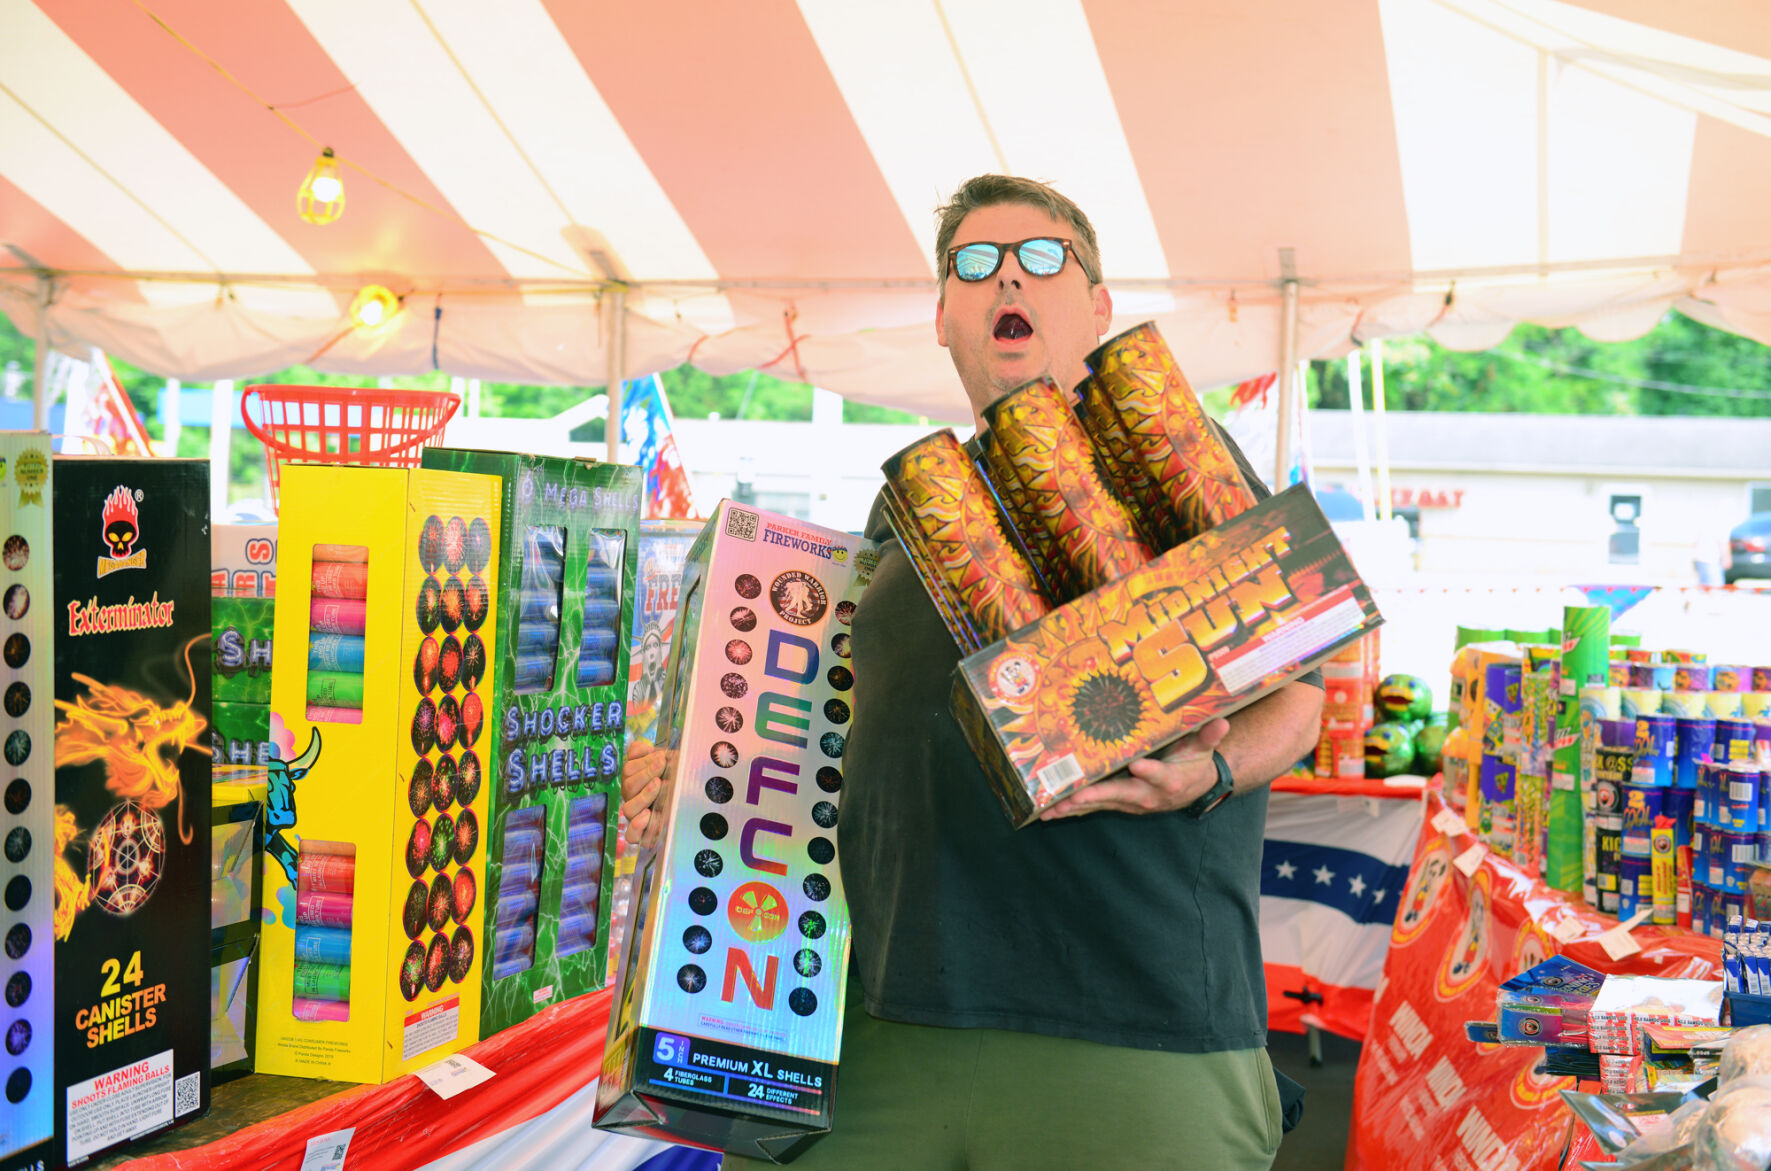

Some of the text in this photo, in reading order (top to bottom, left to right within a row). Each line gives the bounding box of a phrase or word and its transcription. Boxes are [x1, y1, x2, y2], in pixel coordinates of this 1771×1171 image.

[544, 482, 588, 509] MEGA
[594, 487, 640, 511] SHELLS
[763, 529, 832, 560] FIREWORKS
[767, 522, 832, 546] PARKER FAMILY
[772, 571, 827, 605] WOUNDED WARRIOR
[1102, 526, 1291, 664] MIDNIGHT
[68, 591, 174, 636] Exterminator
[780, 610, 812, 625] PROJECT
[1133, 559, 1297, 714] SUN
[507, 701, 623, 741] SHOCKER
[507, 744, 617, 792] SHELLS
[100, 951, 144, 997] 24
[75, 984, 167, 1031] CANISTER
[86, 1008, 157, 1049] SHELLS
[656, 1037, 675, 1061] 5
[94, 1062, 149, 1091] WARNING
[663, 1067, 712, 1083] 4 FIBERGLASS
[674, 1076, 695, 1086] TUBES
[693, 1053, 822, 1087] PREMIUM XL SHELLS
[72, 1065, 170, 1110] SHOOTS FLAMING BALLS
[748, 1083, 799, 1100] 24 DIFFERENT
[766, 1093, 792, 1105] EFFECTS
